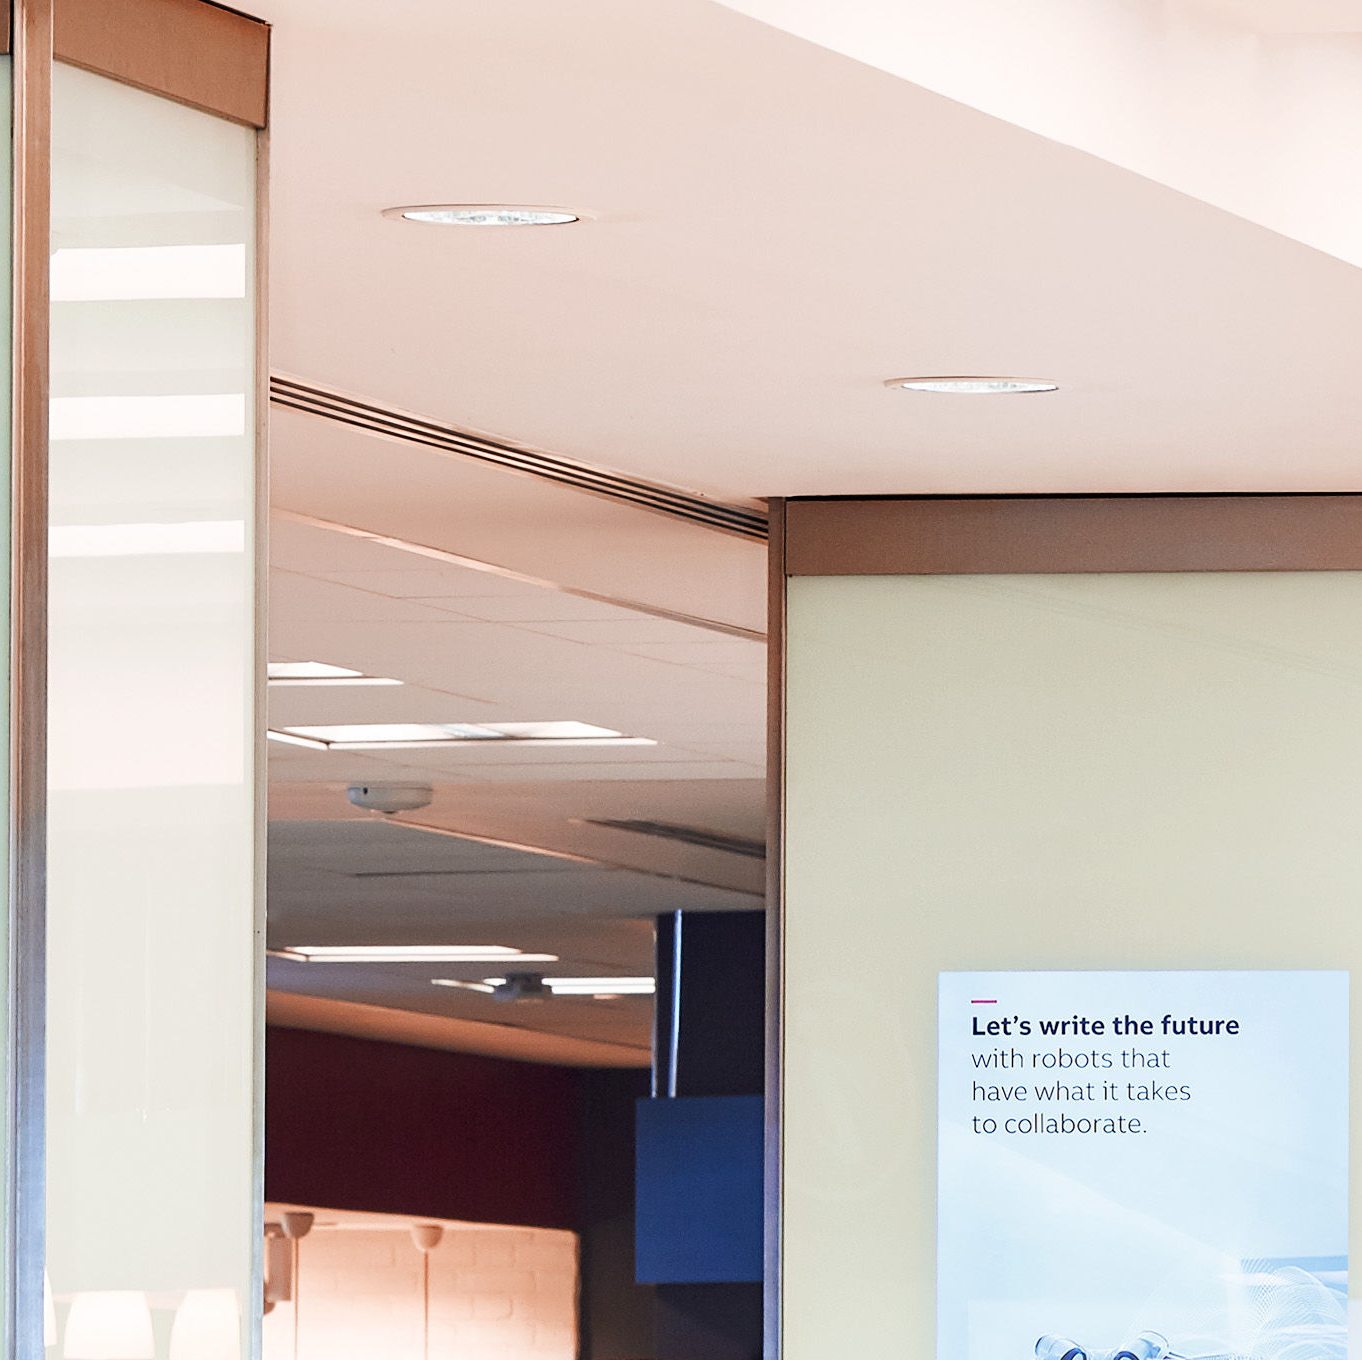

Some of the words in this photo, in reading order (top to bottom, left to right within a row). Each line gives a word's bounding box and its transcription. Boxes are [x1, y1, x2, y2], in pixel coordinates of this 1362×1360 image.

[972, 1014, 1031, 1036] Let’s
[1040, 1014, 1105, 1036] write
[1113, 1014, 1154, 1036] the
[1161, 1014, 1240, 1036] future
[972, 1047, 1024, 1069] with
[1032, 1047, 1113, 1069] robots
[1121, 1047, 1171, 1069] that
[972, 1080, 1028, 1102] have
[1035, 1080, 1095, 1102] what
[1102, 1080, 1118, 1102] it
[1126, 1080, 1191, 1102] takes
[972, 1113, 997, 1135] to
[1004, 1113, 1147, 1135] collaborate.
